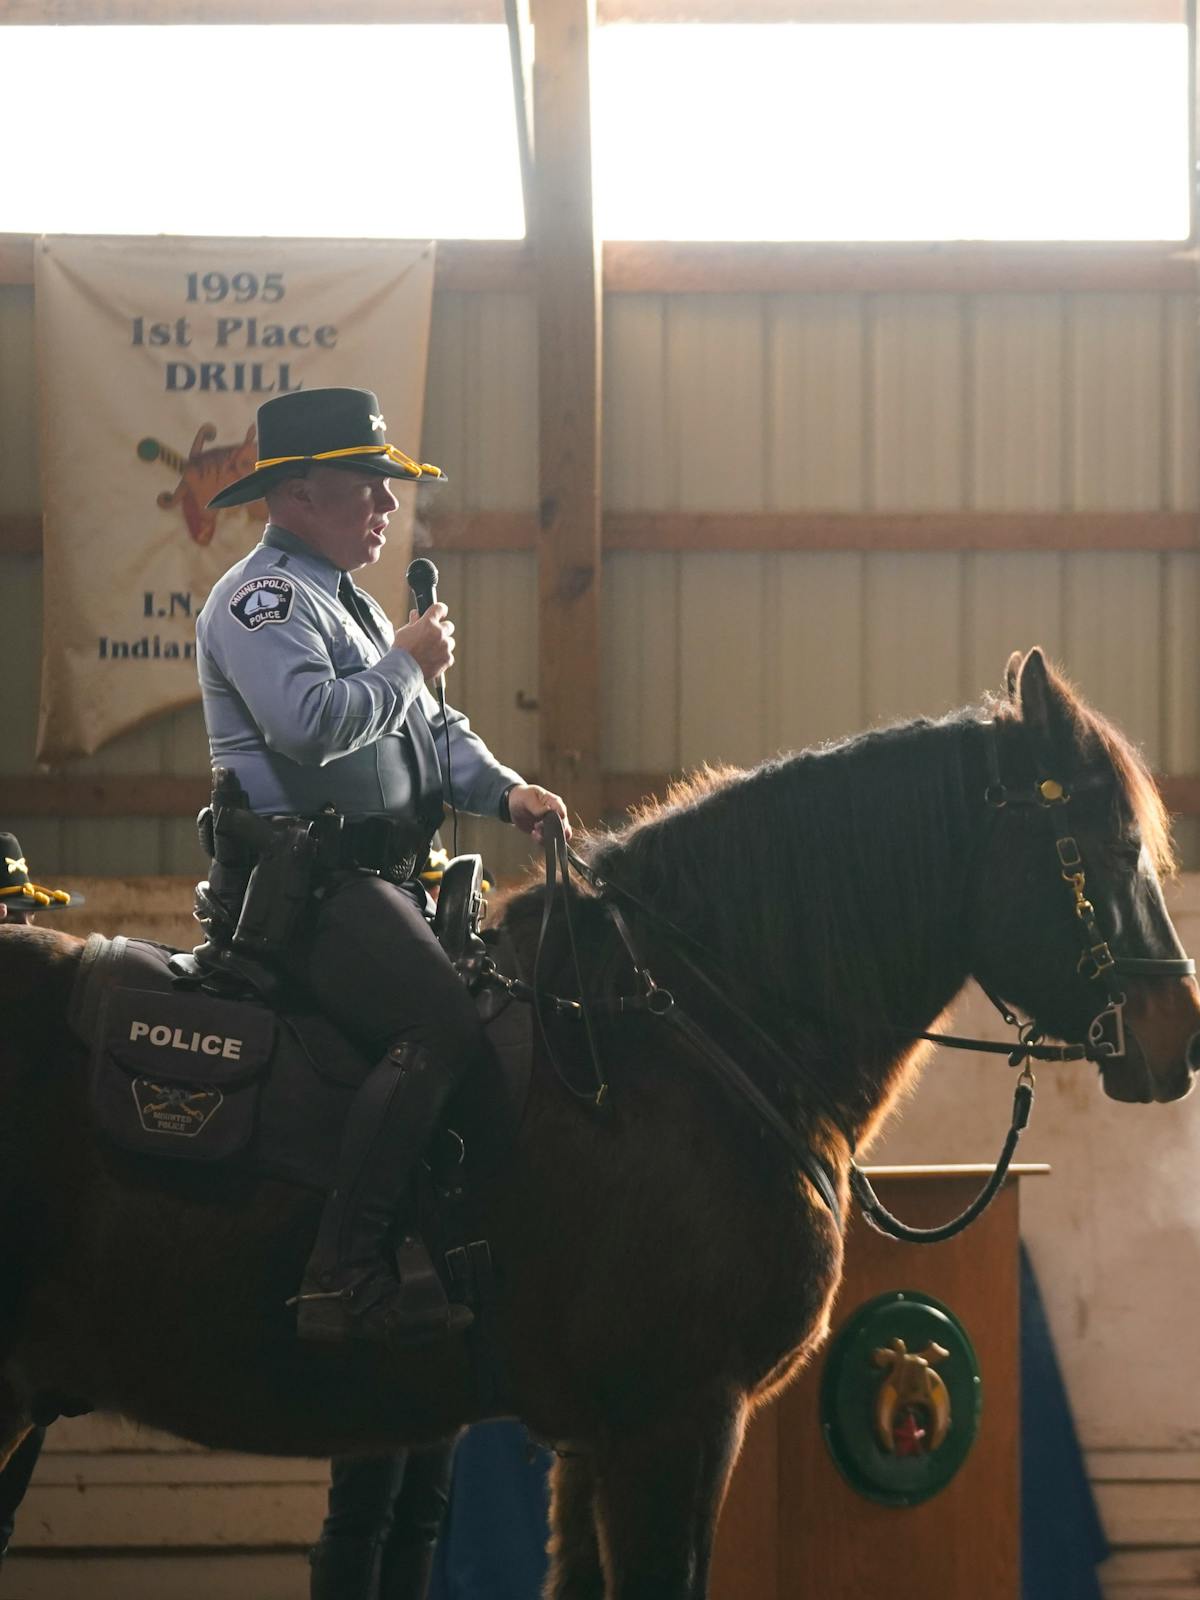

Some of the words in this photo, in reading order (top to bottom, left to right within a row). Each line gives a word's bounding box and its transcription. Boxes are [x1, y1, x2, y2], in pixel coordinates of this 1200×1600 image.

[184, 272, 286, 302] 1995
[131, 316, 192, 347] 1st
[215, 316, 339, 348] Place
[165, 362, 303, 391] DRILL
[143, 592, 200, 618] I.N.
[231, 580, 290, 606] MINNEAPOLIS
[249, 611, 281, 625] POLICE
[98, 637, 198, 660] Indian
[129, 1021, 243, 1060] POLICE
